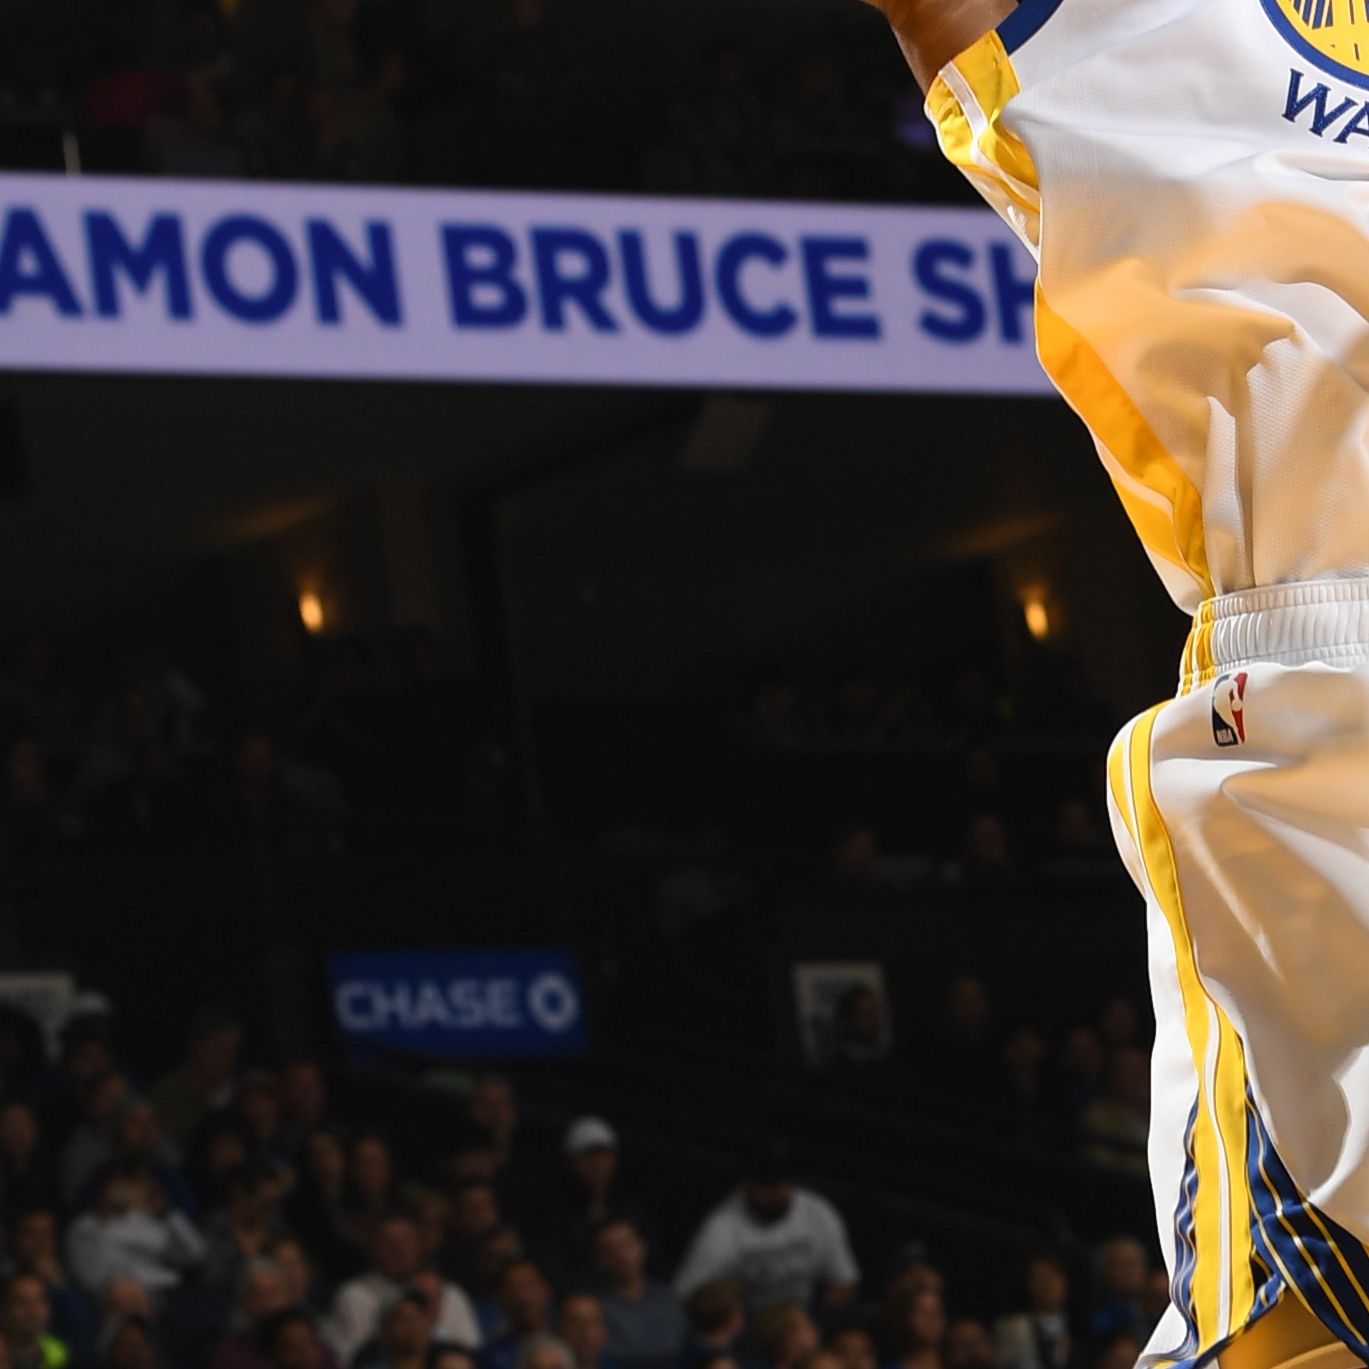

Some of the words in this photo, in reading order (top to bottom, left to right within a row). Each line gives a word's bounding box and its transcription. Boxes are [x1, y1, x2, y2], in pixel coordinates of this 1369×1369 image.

[0, 207, 405, 328] AMON
[441, 222, 881, 340] BRUCE
[914, 239, 1034, 343] SH
[1215, 728, 1235, 744] NBA
[333, 977, 522, 1032] CHASE
